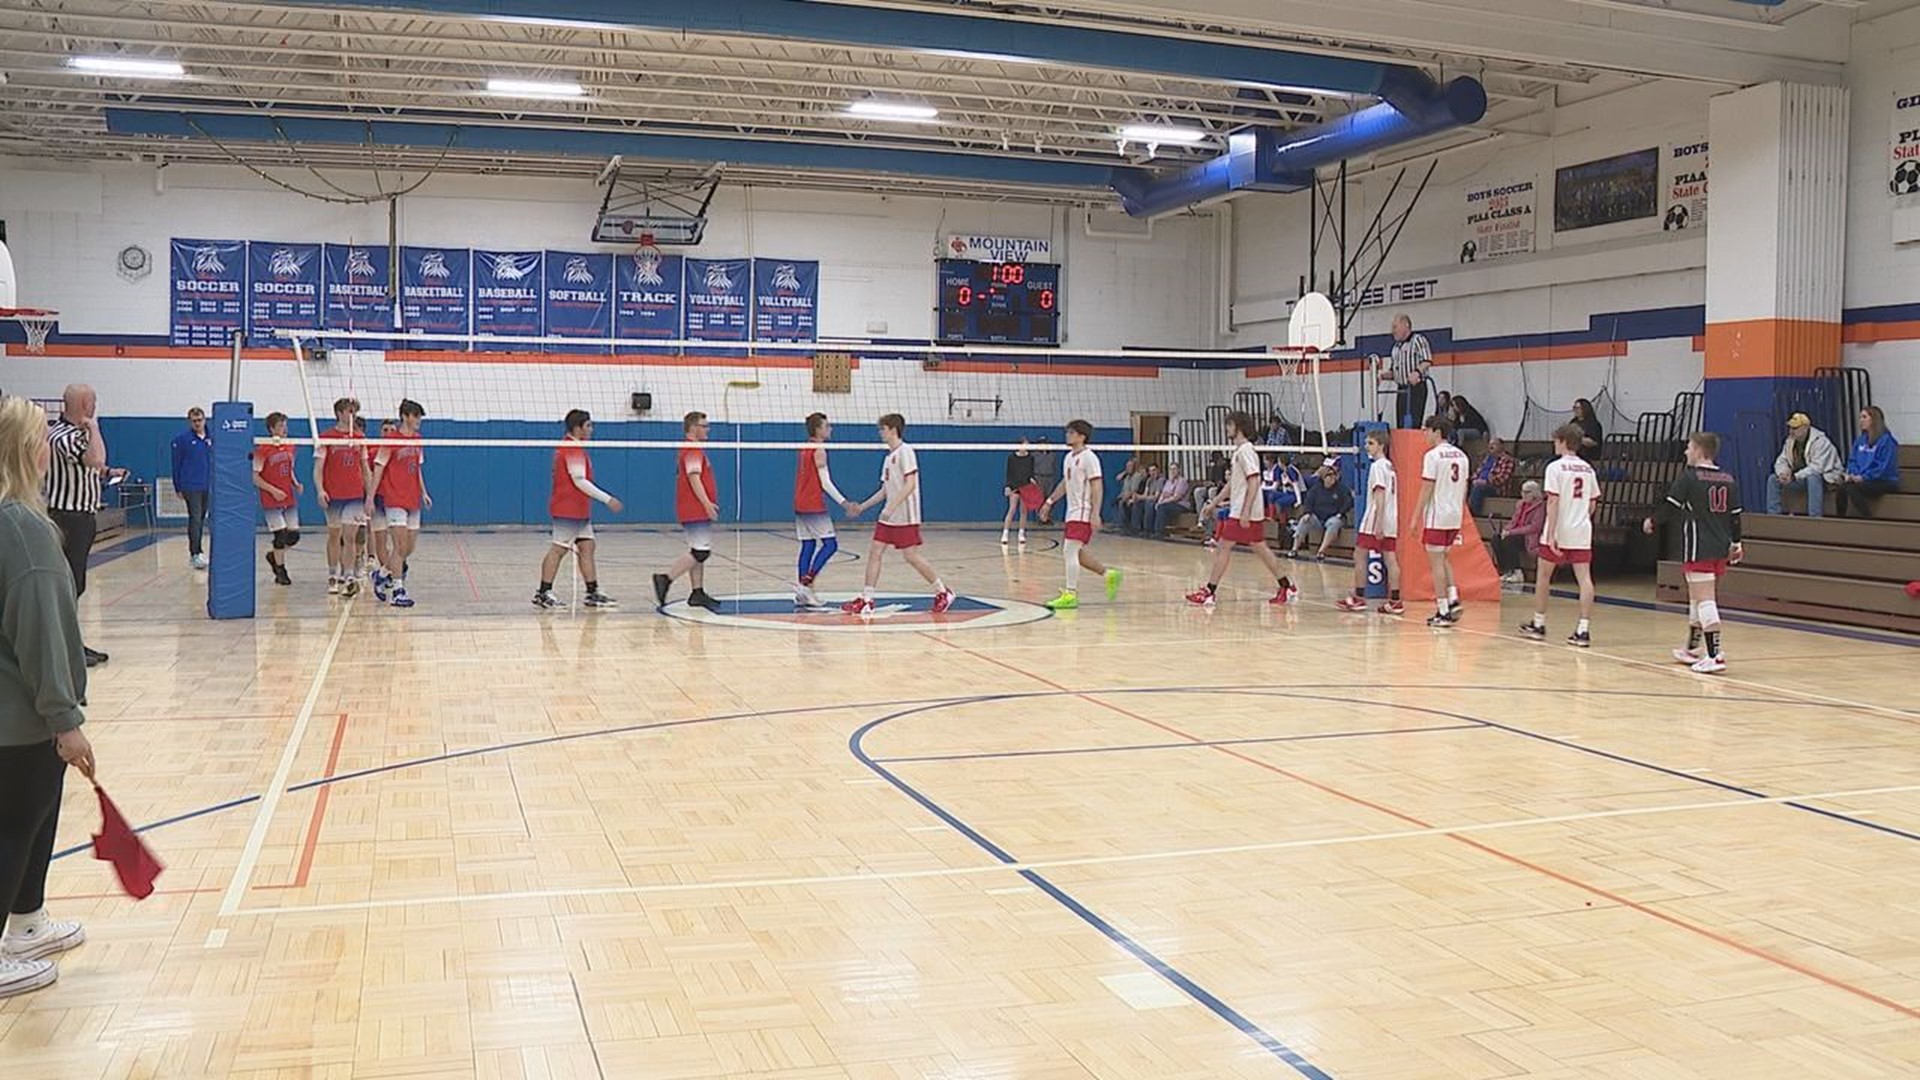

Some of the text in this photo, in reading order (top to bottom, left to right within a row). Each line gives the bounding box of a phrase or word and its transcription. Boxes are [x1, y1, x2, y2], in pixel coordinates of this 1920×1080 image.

[1674, 142, 1709, 158] BOYS
[1674, 171, 1707, 185] PIAA
[1467, 182, 1533, 202] BOYS SOCCER
[1672, 185, 1700, 200] State
[1490, 206, 1522, 219] CLASS
[1523, 204, 1532, 214] A
[969, 237, 1049, 252] MOUNTAIN
[990, 250, 1028, 262] VIEW
[176, 280, 240, 293] SOCCER
[254, 282, 315, 295] SOCCER
[946, 277, 969, 286] HOME
[1027, 281, 1052, 290] GUEST
[404, 286, 464, 298] BASKETBALL
[478, 287, 537, 299] BASEBALL
[549, 289, 607, 302] SOFTBALL
[959, 286, 971, 305] 0
[1390, 279, 1438, 301] NEST
[619, 291, 676, 304] TRACK
[689, 294, 745, 307] VOLLEYBALL
[758, 296, 813, 308] VOLLEYBALL
[1040, 290, 1053, 309] 0
[1451, 462, 1460, 483] 3
[1572, 477, 1583, 499] 2
[1708, 485, 1728, 513] 11
